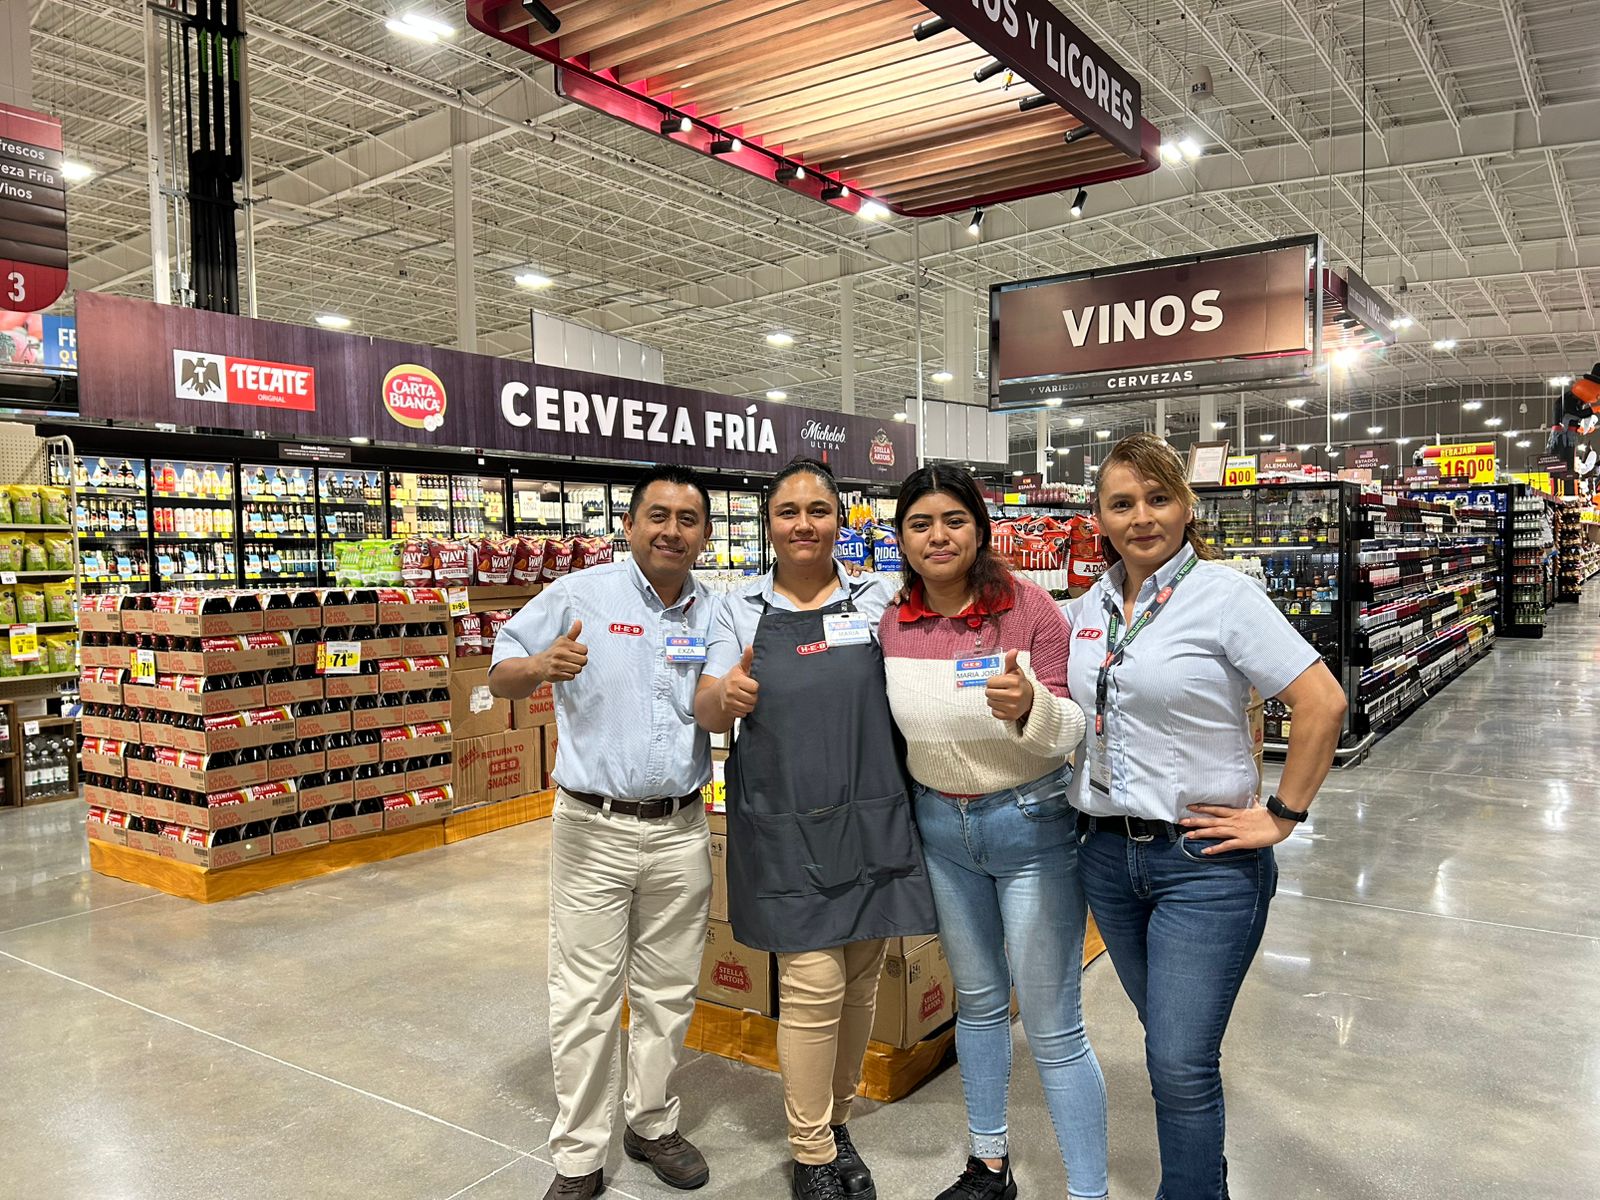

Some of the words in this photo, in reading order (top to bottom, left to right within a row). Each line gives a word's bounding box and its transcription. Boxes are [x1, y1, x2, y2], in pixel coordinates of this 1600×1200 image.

[971, 0, 1019, 38] OS
[1027, 11, 1039, 49] Y
[1046, 20, 1134, 130] LICORES
[0, 164, 24, 177] eza
[29, 168, 54, 184] Fría
[7, 272, 26, 302] 3
[1062, 289, 1224, 347] VINOS
[230, 363, 310, 395] TECATE
[1107, 370, 1193, 389] CERVEZAS
[392, 379, 436, 398] CARTA
[258, 394, 286, 403] ORIGINAL
[389, 392, 440, 411] BLANCA
[501, 381, 696, 446] CERVEZA
[704, 404, 778, 454] FRÍA
[800, 420, 846, 443] Michelob
[810, 441, 839, 451] ULTRA
[1440, 446, 1477, 457] REBAJADO
[439, 550, 466, 564] WAVY
[835, 542, 863, 557] DGED
[874, 546, 902, 561] RIDGE
[491, 555, 510, 568] WAV
[1020, 549, 1058, 569] THIN
[613, 624, 640, 633] H-E-B
[529, 702, 555, 714] SNACK
[481, 747, 512, 759] RETURN
[514, 744, 524, 752] TO
[491, 760, 517, 772] H-E-B
[719, 966, 743, 977] STELLA
[719, 975, 744, 985] ARTOIS
